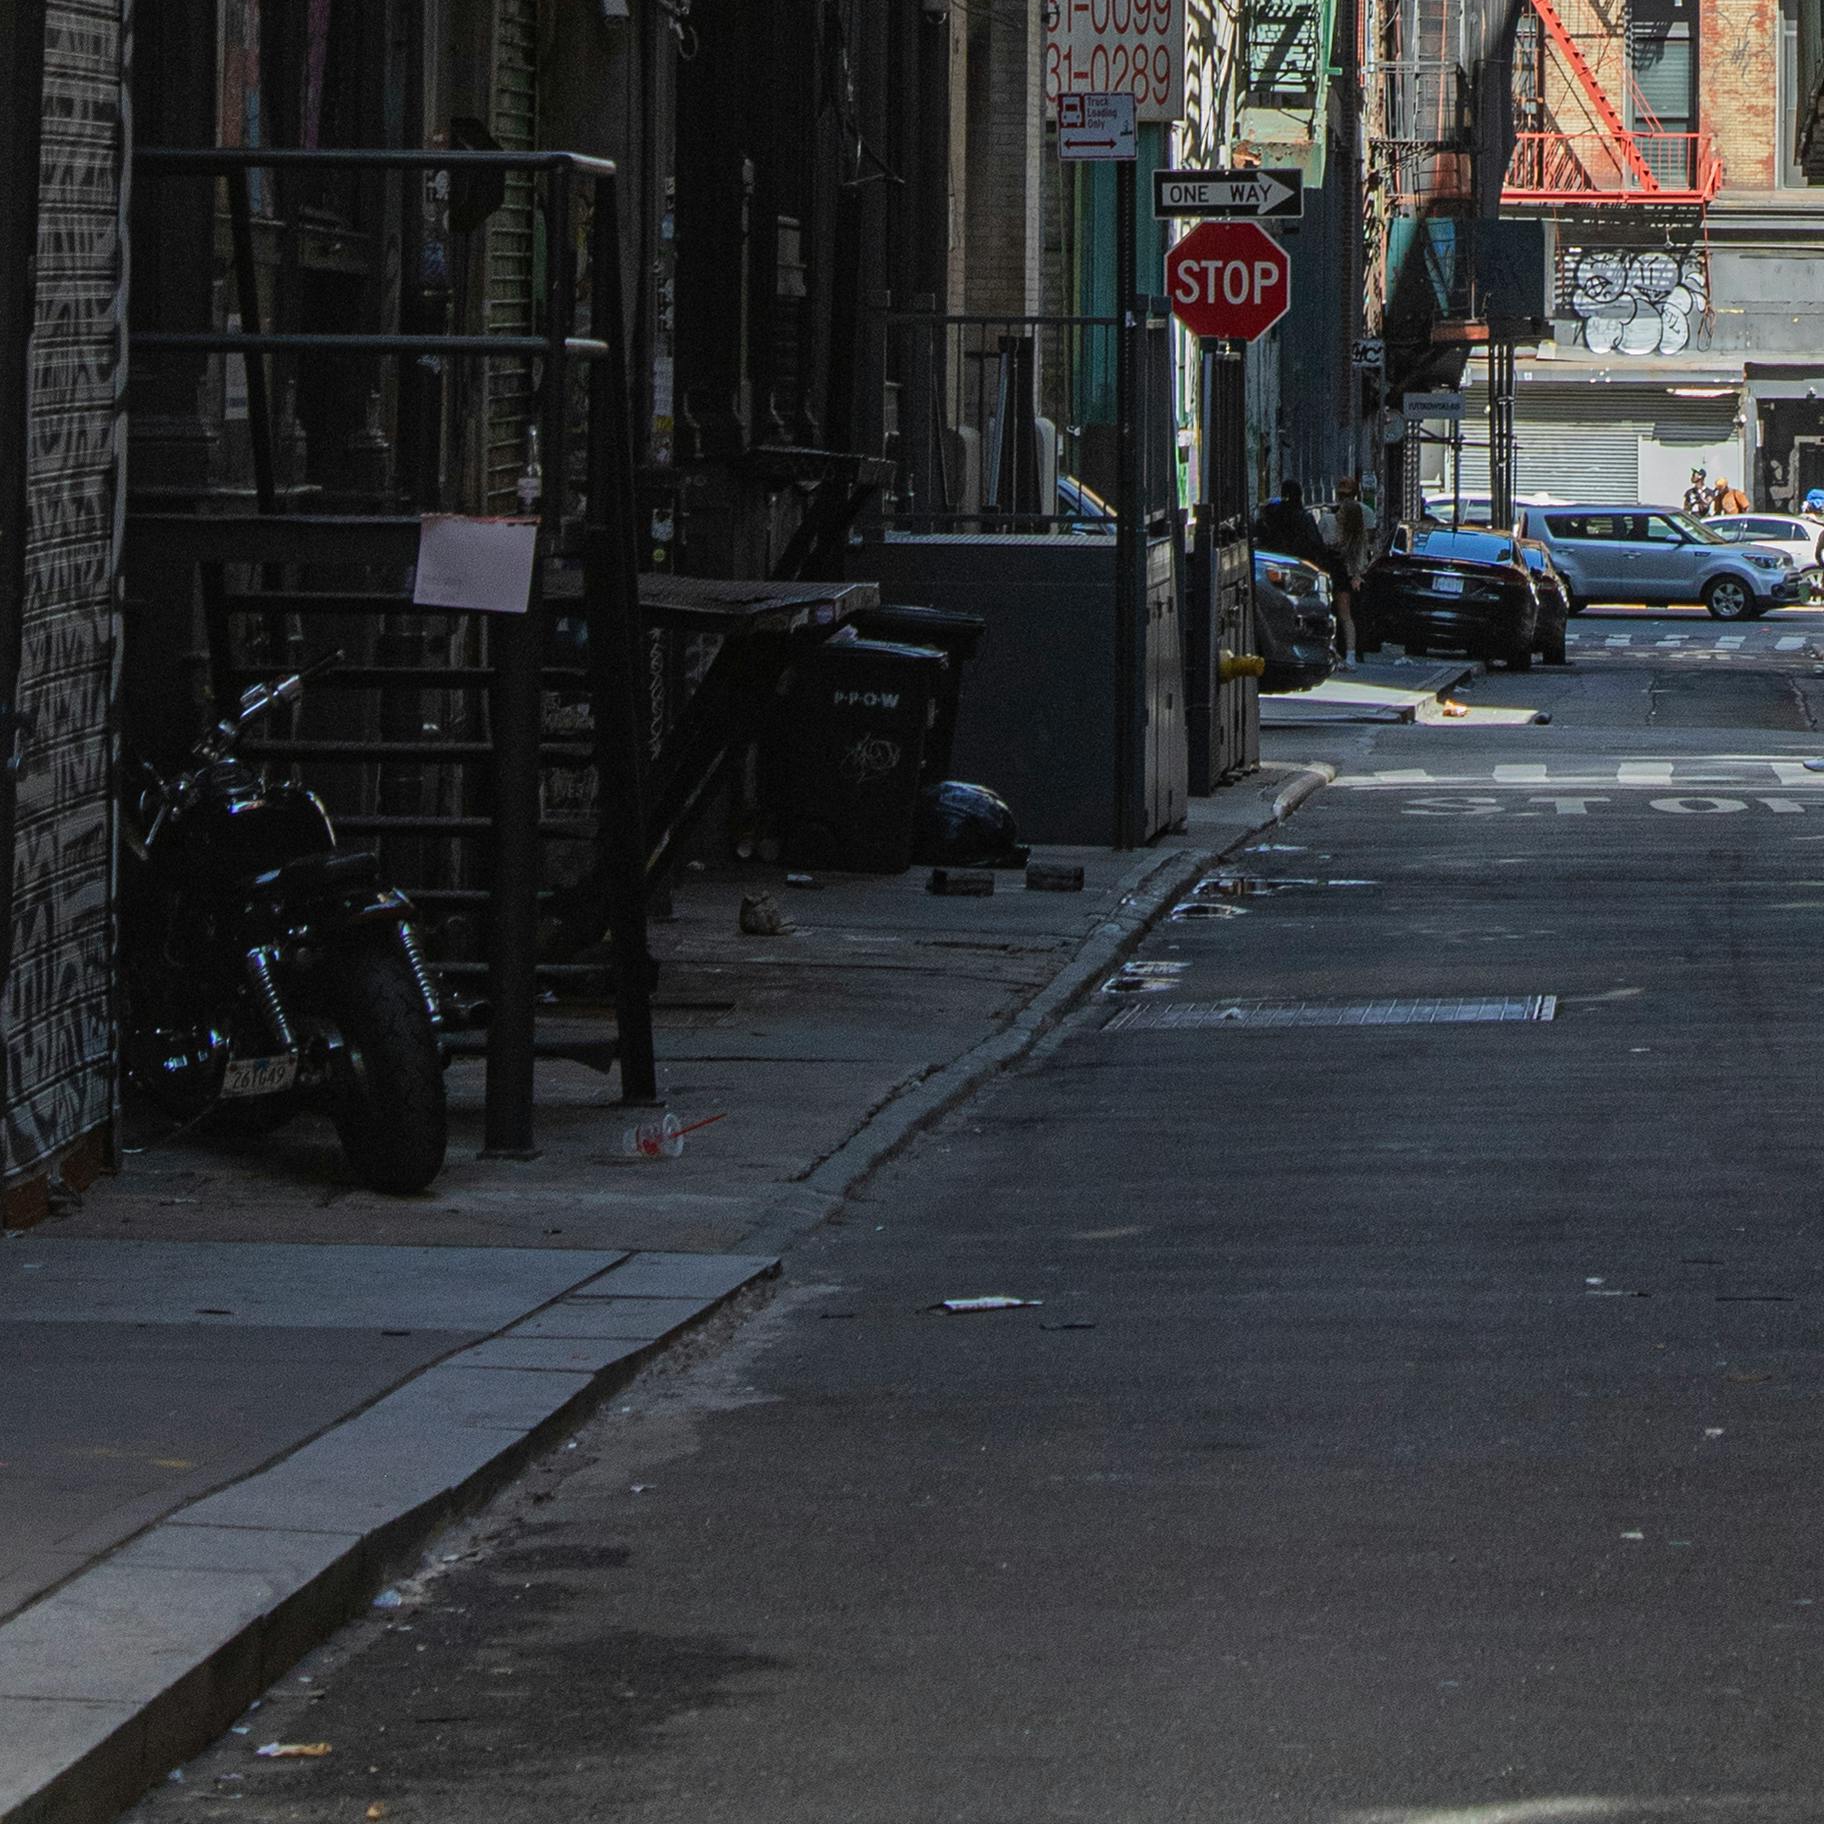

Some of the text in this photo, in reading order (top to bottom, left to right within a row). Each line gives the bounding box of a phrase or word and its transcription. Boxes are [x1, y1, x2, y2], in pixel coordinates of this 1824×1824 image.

[1088, 96, 1108, 106] Truck
[1088, 108, 1118, 119] Loading
[1088, 119, 1105, 130] Only
[1170, 184, 1273, 203] ONE WAY
[1175, 259, 1280, 305] STOP
